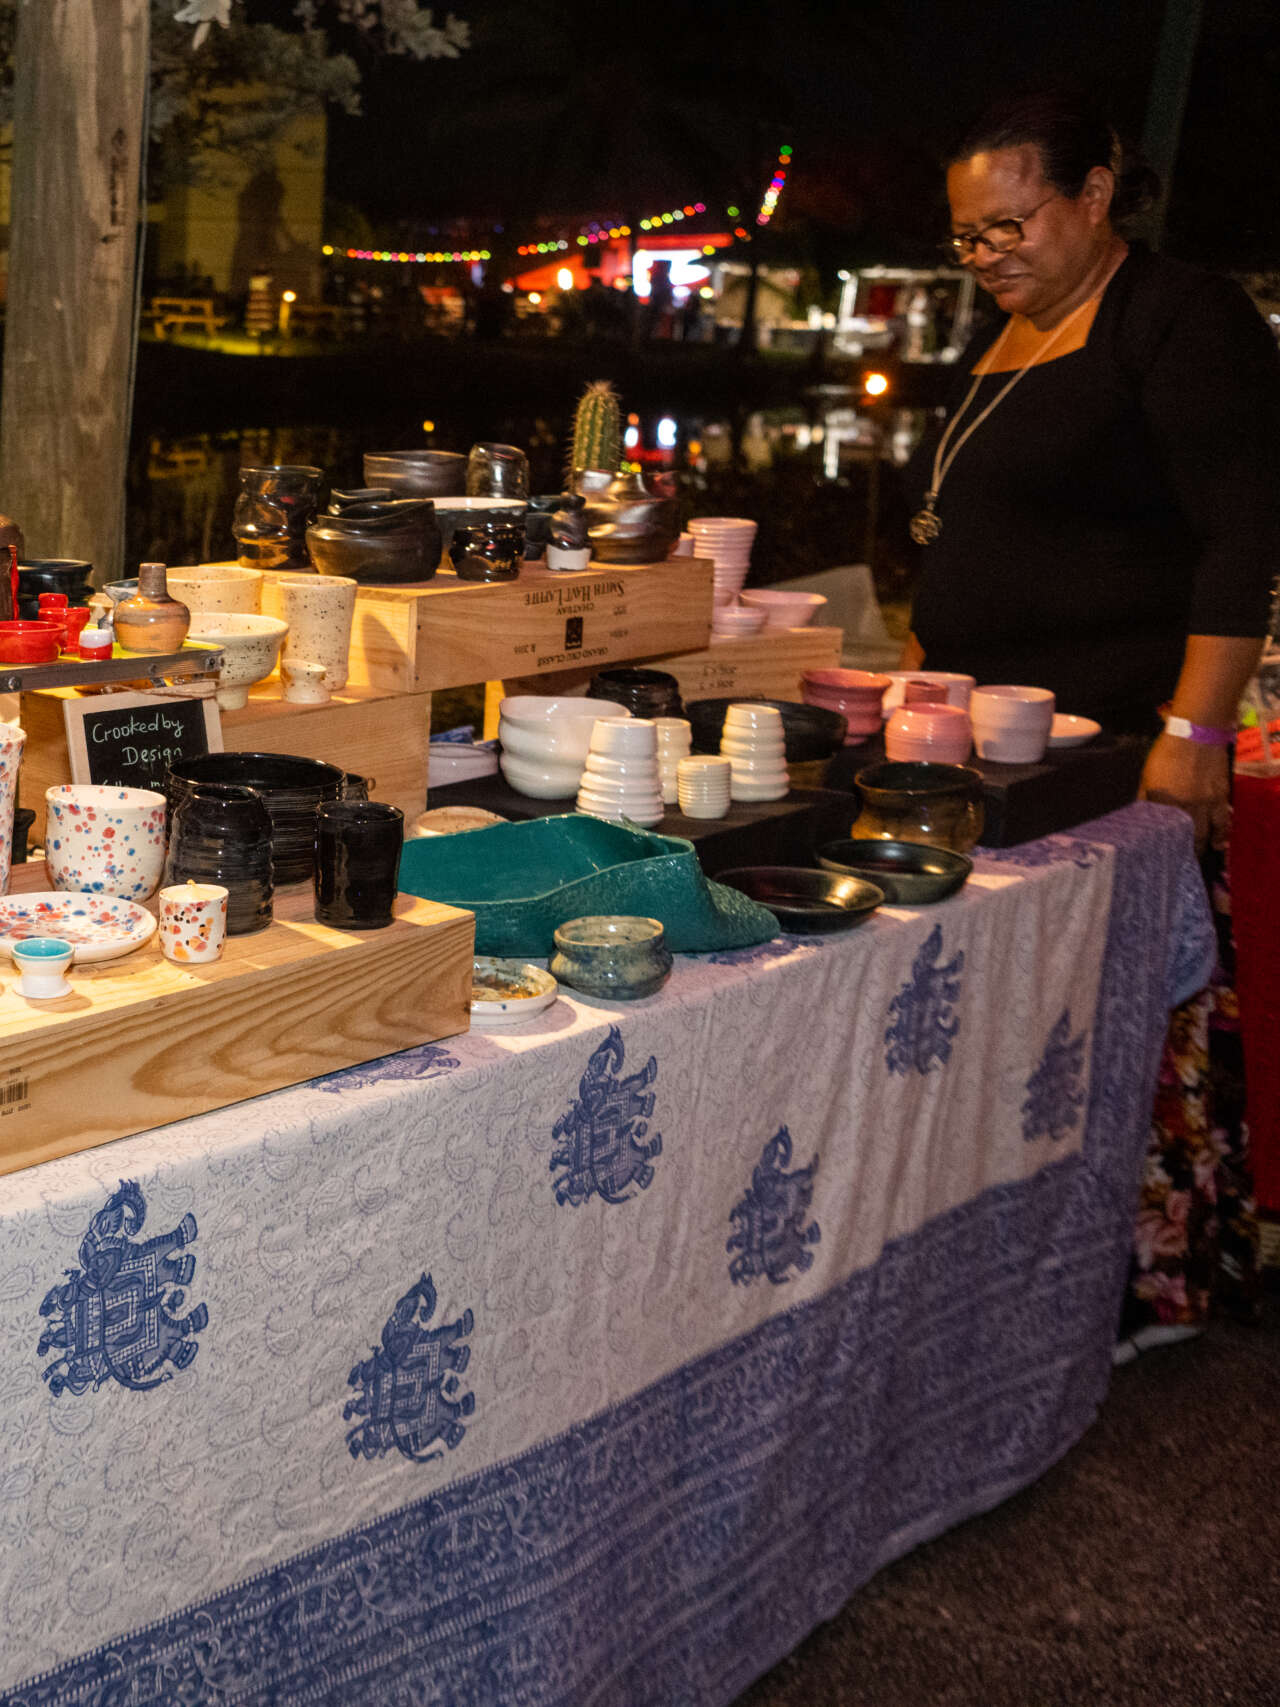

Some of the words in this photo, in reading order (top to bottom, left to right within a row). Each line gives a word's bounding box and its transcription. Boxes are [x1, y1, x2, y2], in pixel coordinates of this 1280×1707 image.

[92, 712, 159, 743] Crooked
[161, 713, 185, 738] by
[121, 744, 183, 767] Design
